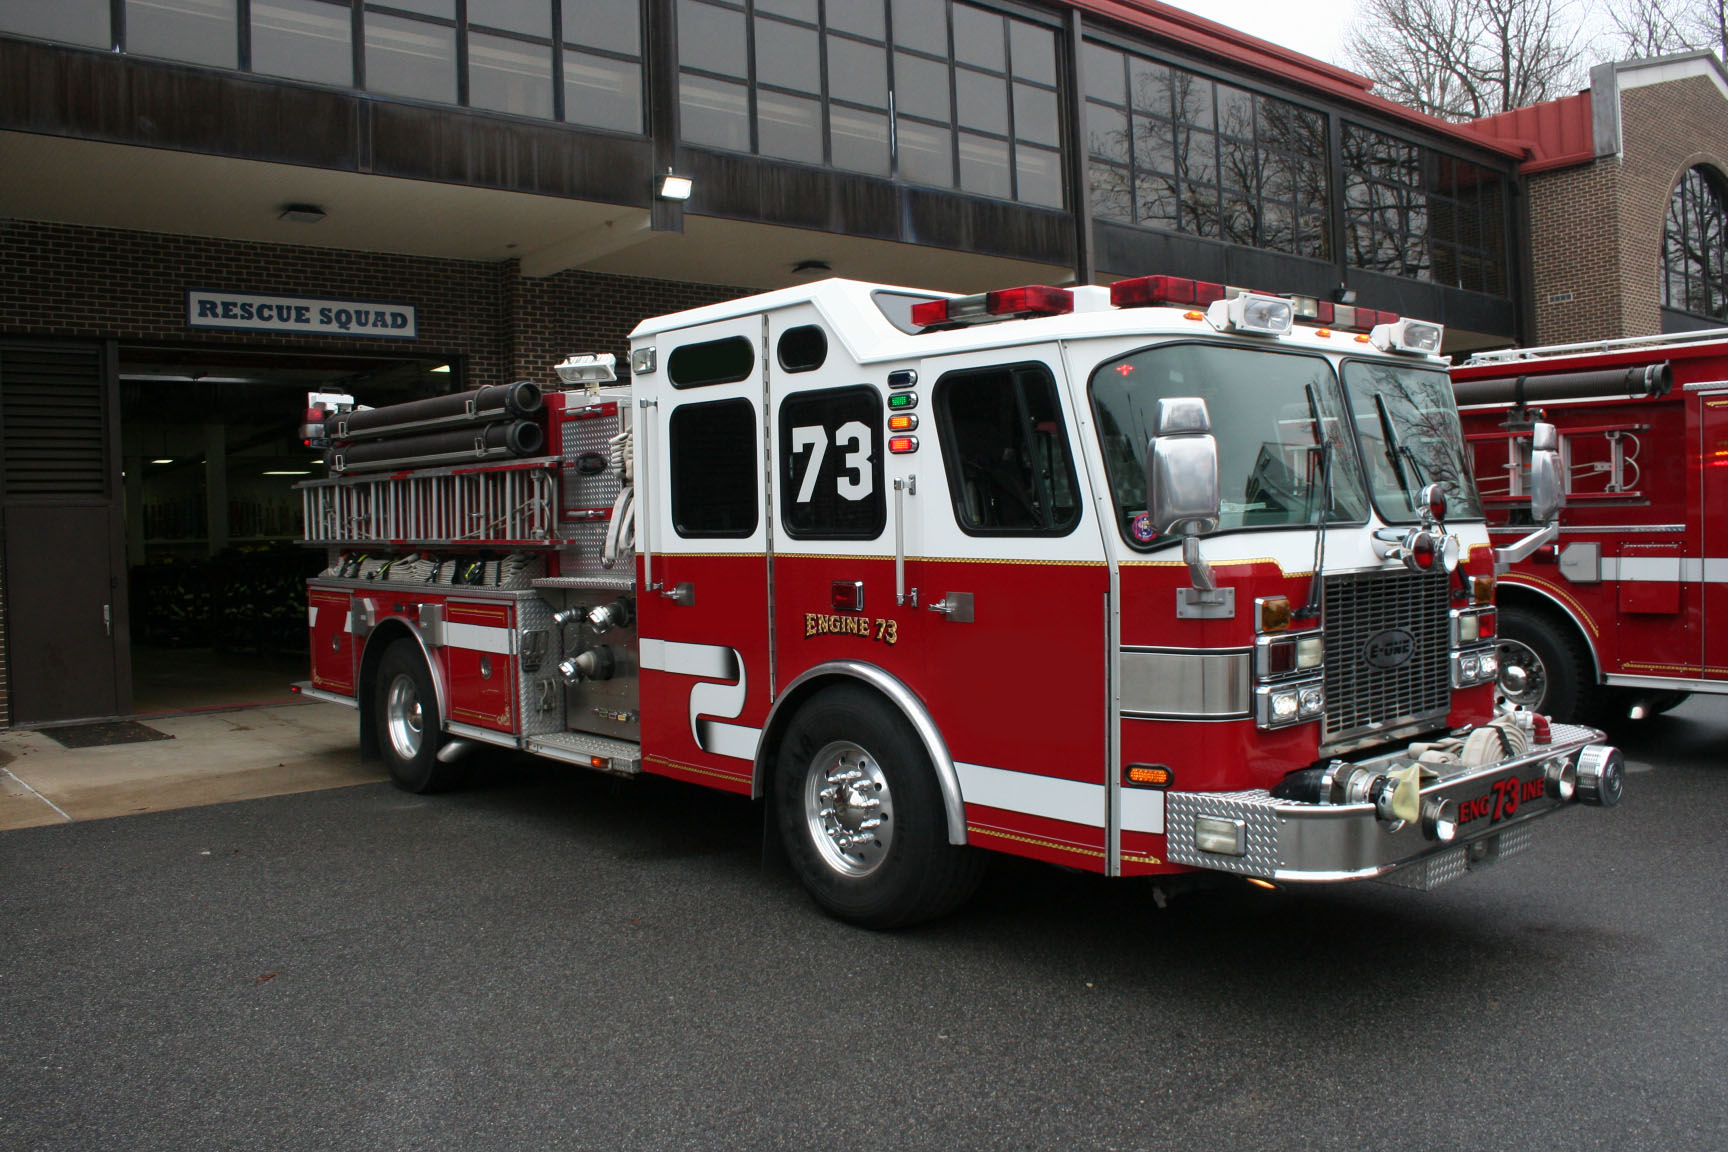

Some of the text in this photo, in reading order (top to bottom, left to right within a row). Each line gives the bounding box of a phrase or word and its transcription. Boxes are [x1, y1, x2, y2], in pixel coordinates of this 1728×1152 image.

[198, 300, 408, 331] RESCUE SQUAD
[792, 421, 873, 502] 73
[805, 613, 898, 645] ENGINE 73
[1491, 776, 1520, 821] 73
